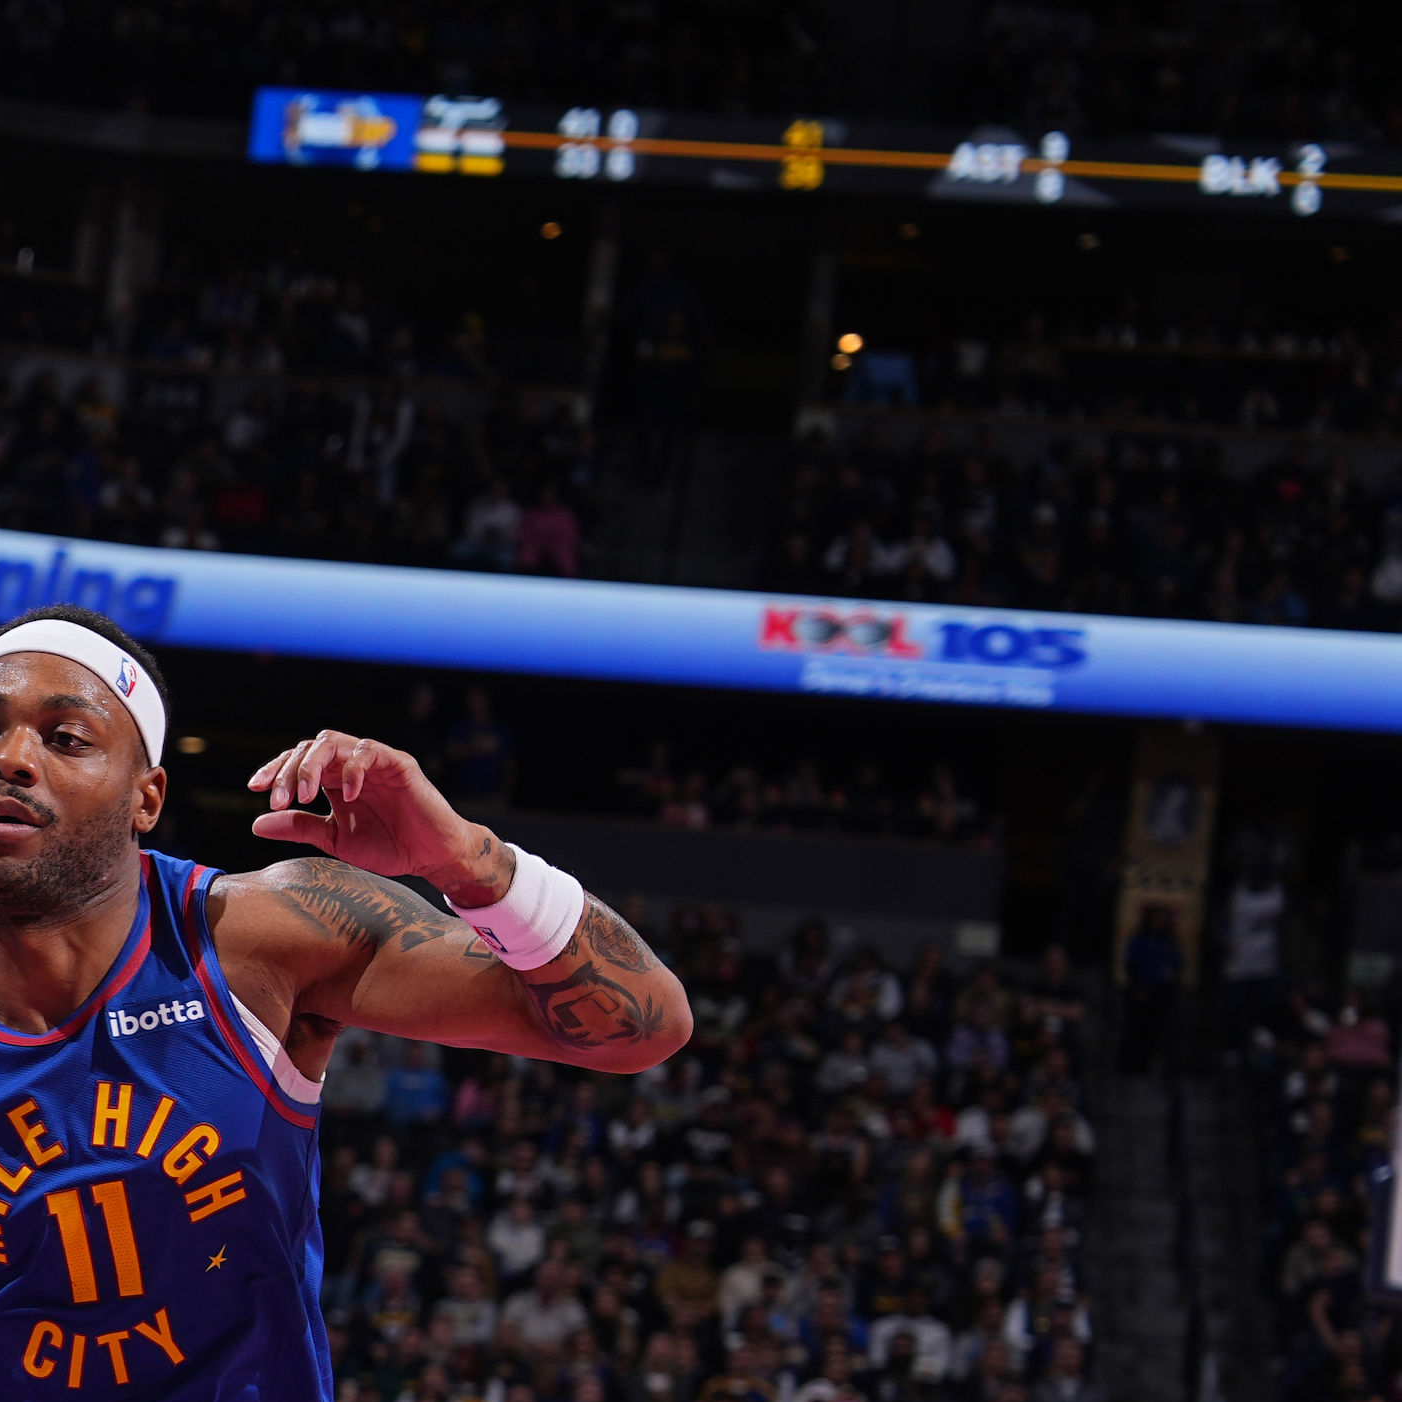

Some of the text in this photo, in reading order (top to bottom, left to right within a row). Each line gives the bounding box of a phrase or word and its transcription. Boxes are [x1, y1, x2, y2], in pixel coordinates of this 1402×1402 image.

[947, 142, 1027, 183] AST
[1201, 144, 1327, 196] BLK 2
[939, 621, 1088, 671] 105
[108, 999, 205, 1036] ibotta
[92, 1081, 247, 1224] HIGH
[44, 1180, 145, 1303] 11
[21, 1307, 187, 1389] CITY
